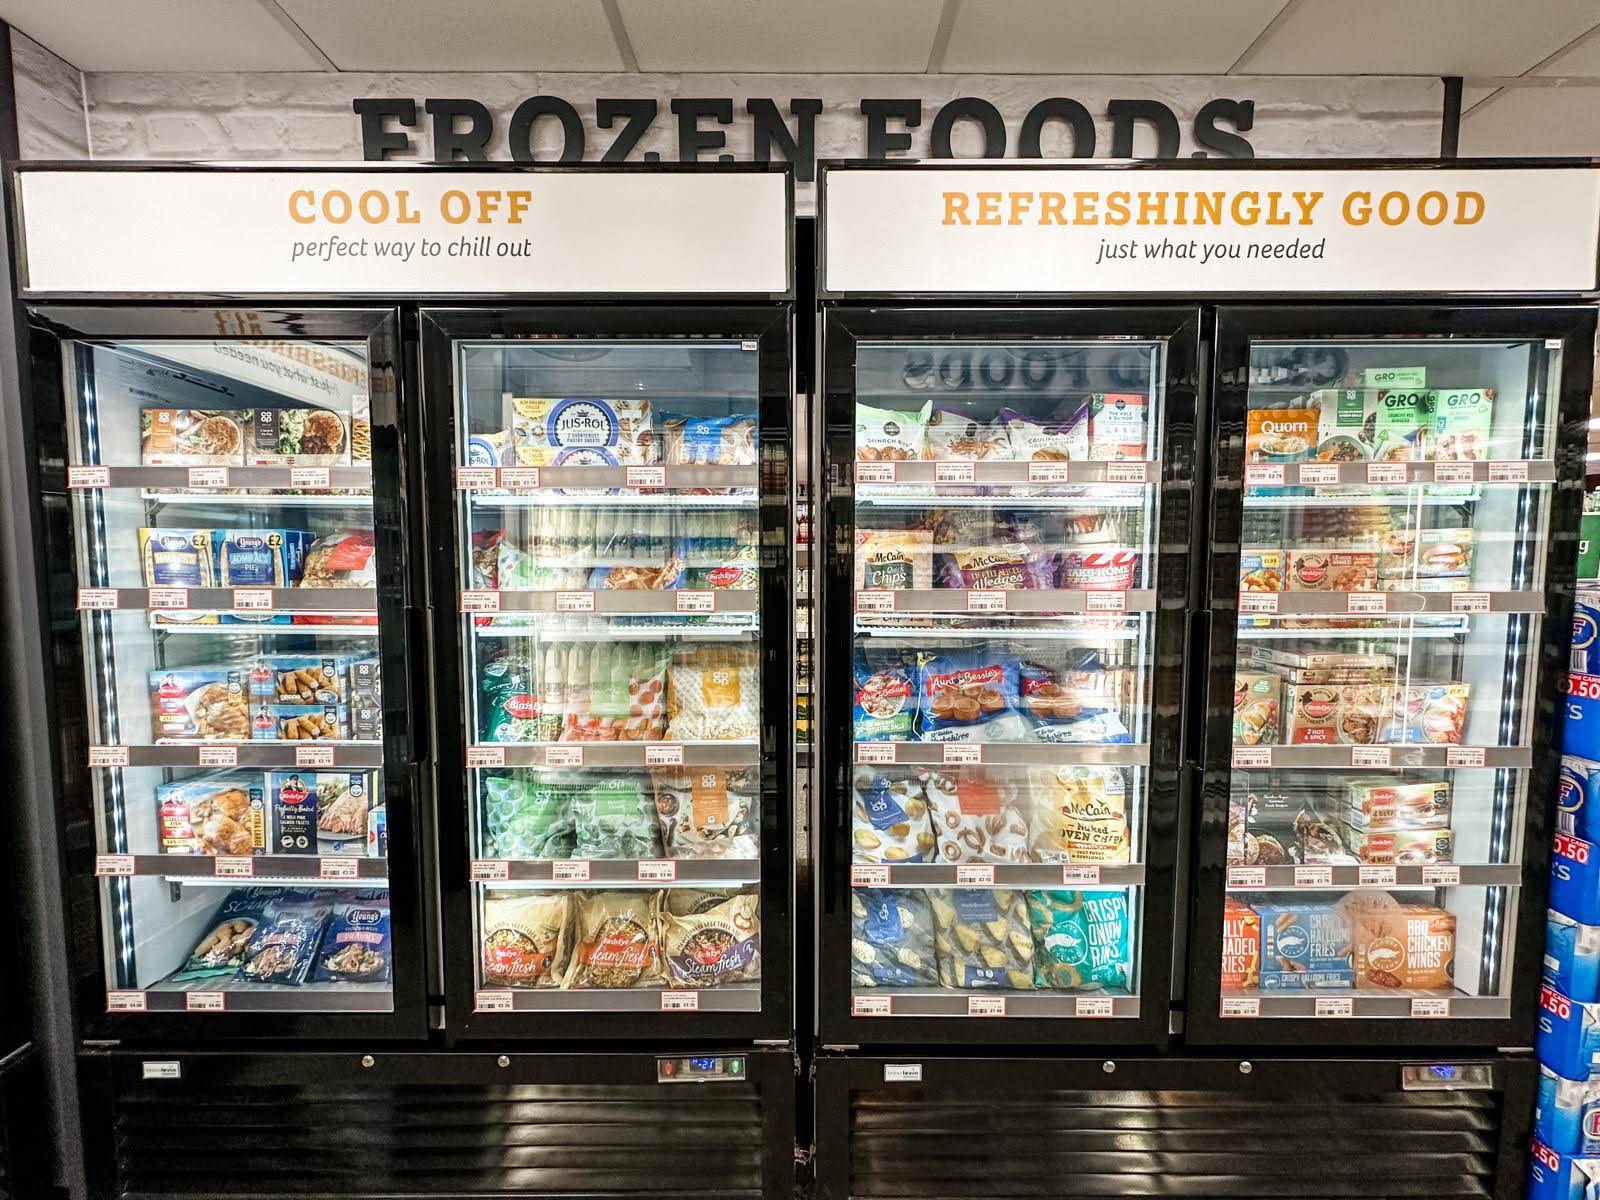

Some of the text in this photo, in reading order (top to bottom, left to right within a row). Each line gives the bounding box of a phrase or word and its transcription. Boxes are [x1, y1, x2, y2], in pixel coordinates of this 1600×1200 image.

[353, 96, 1254, 182] FROZEN FOODS
[289, 190, 532, 224] COOL OFF
[941, 191, 1486, 226] REFRESHINGLY GOOD
[292, 236, 532, 262] perfect way to chill out
[1096, 238, 1325, 265] just what you needed
[1374, 372, 1396, 381] GRO
[1385, 393, 1419, 408] GRO
[1427, 391, 1436, 414] GRO
[1447, 392, 1481, 406] GRO
[1261, 420, 1308, 434] Quorn
[192, 536, 206, 546] £2
[268, 535, 282, 546] £2
[231, 553, 270, 564] ADMIRAL'S
[875, 549, 904, 562] McCain
[709, 571, 738, 580] BirdsEye
[887, 564, 904, 573] Quick
[873, 571, 907, 585] Chips
[972, 575, 1025, 590] Wedges
[932, 669, 998, 688] Aunt Bessie's
[1070, 802, 1111, 816] McCain
[1077, 822, 1108, 835] Naked
[1570, 837, 1589, 849] CANS
[1082, 895, 1127, 922] CRISPY
[352, 911, 379, 924] Young's
[1088, 919, 1122, 946] ONION
[1407, 919, 1429, 936] BBQ
[1309, 943, 1336, 957] FRIES
[1407, 935, 1452, 952] CHICKEN
[684, 950, 742, 974] Steamfresh
[1407, 952, 1441, 969] WINGS
[1553, 991, 1571, 1006] CANS
